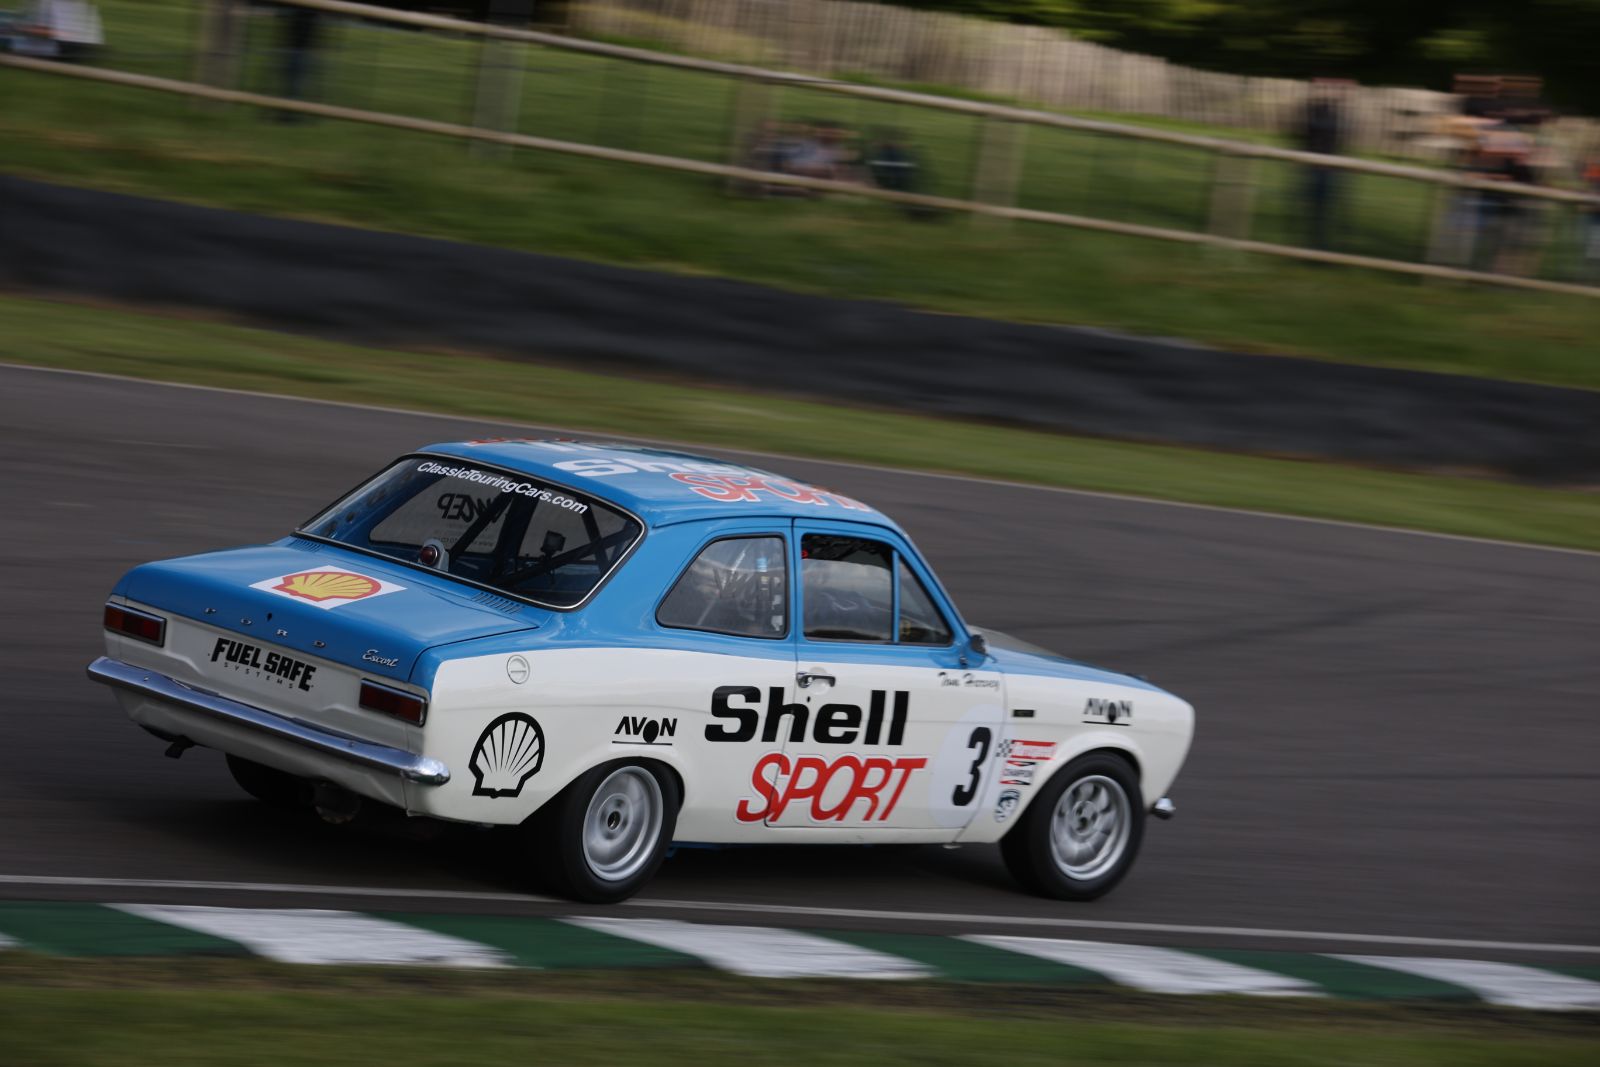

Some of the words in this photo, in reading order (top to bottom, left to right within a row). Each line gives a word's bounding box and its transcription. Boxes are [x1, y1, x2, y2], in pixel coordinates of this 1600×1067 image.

[417, 462, 588, 514] ClassicTouringCars.com
[211, 637, 265, 668] FUEL
[264, 652, 317, 691] SAFE
[224, 662, 294, 689] SYSTEMS
[362, 649, 399, 667] Escort
[615, 716, 677, 743] AVON
[704, 686, 910, 745] Shell
[1084, 698, 1133, 723] AVON
[736, 753, 928, 822] SPORT
[952, 727, 992, 806] 3
